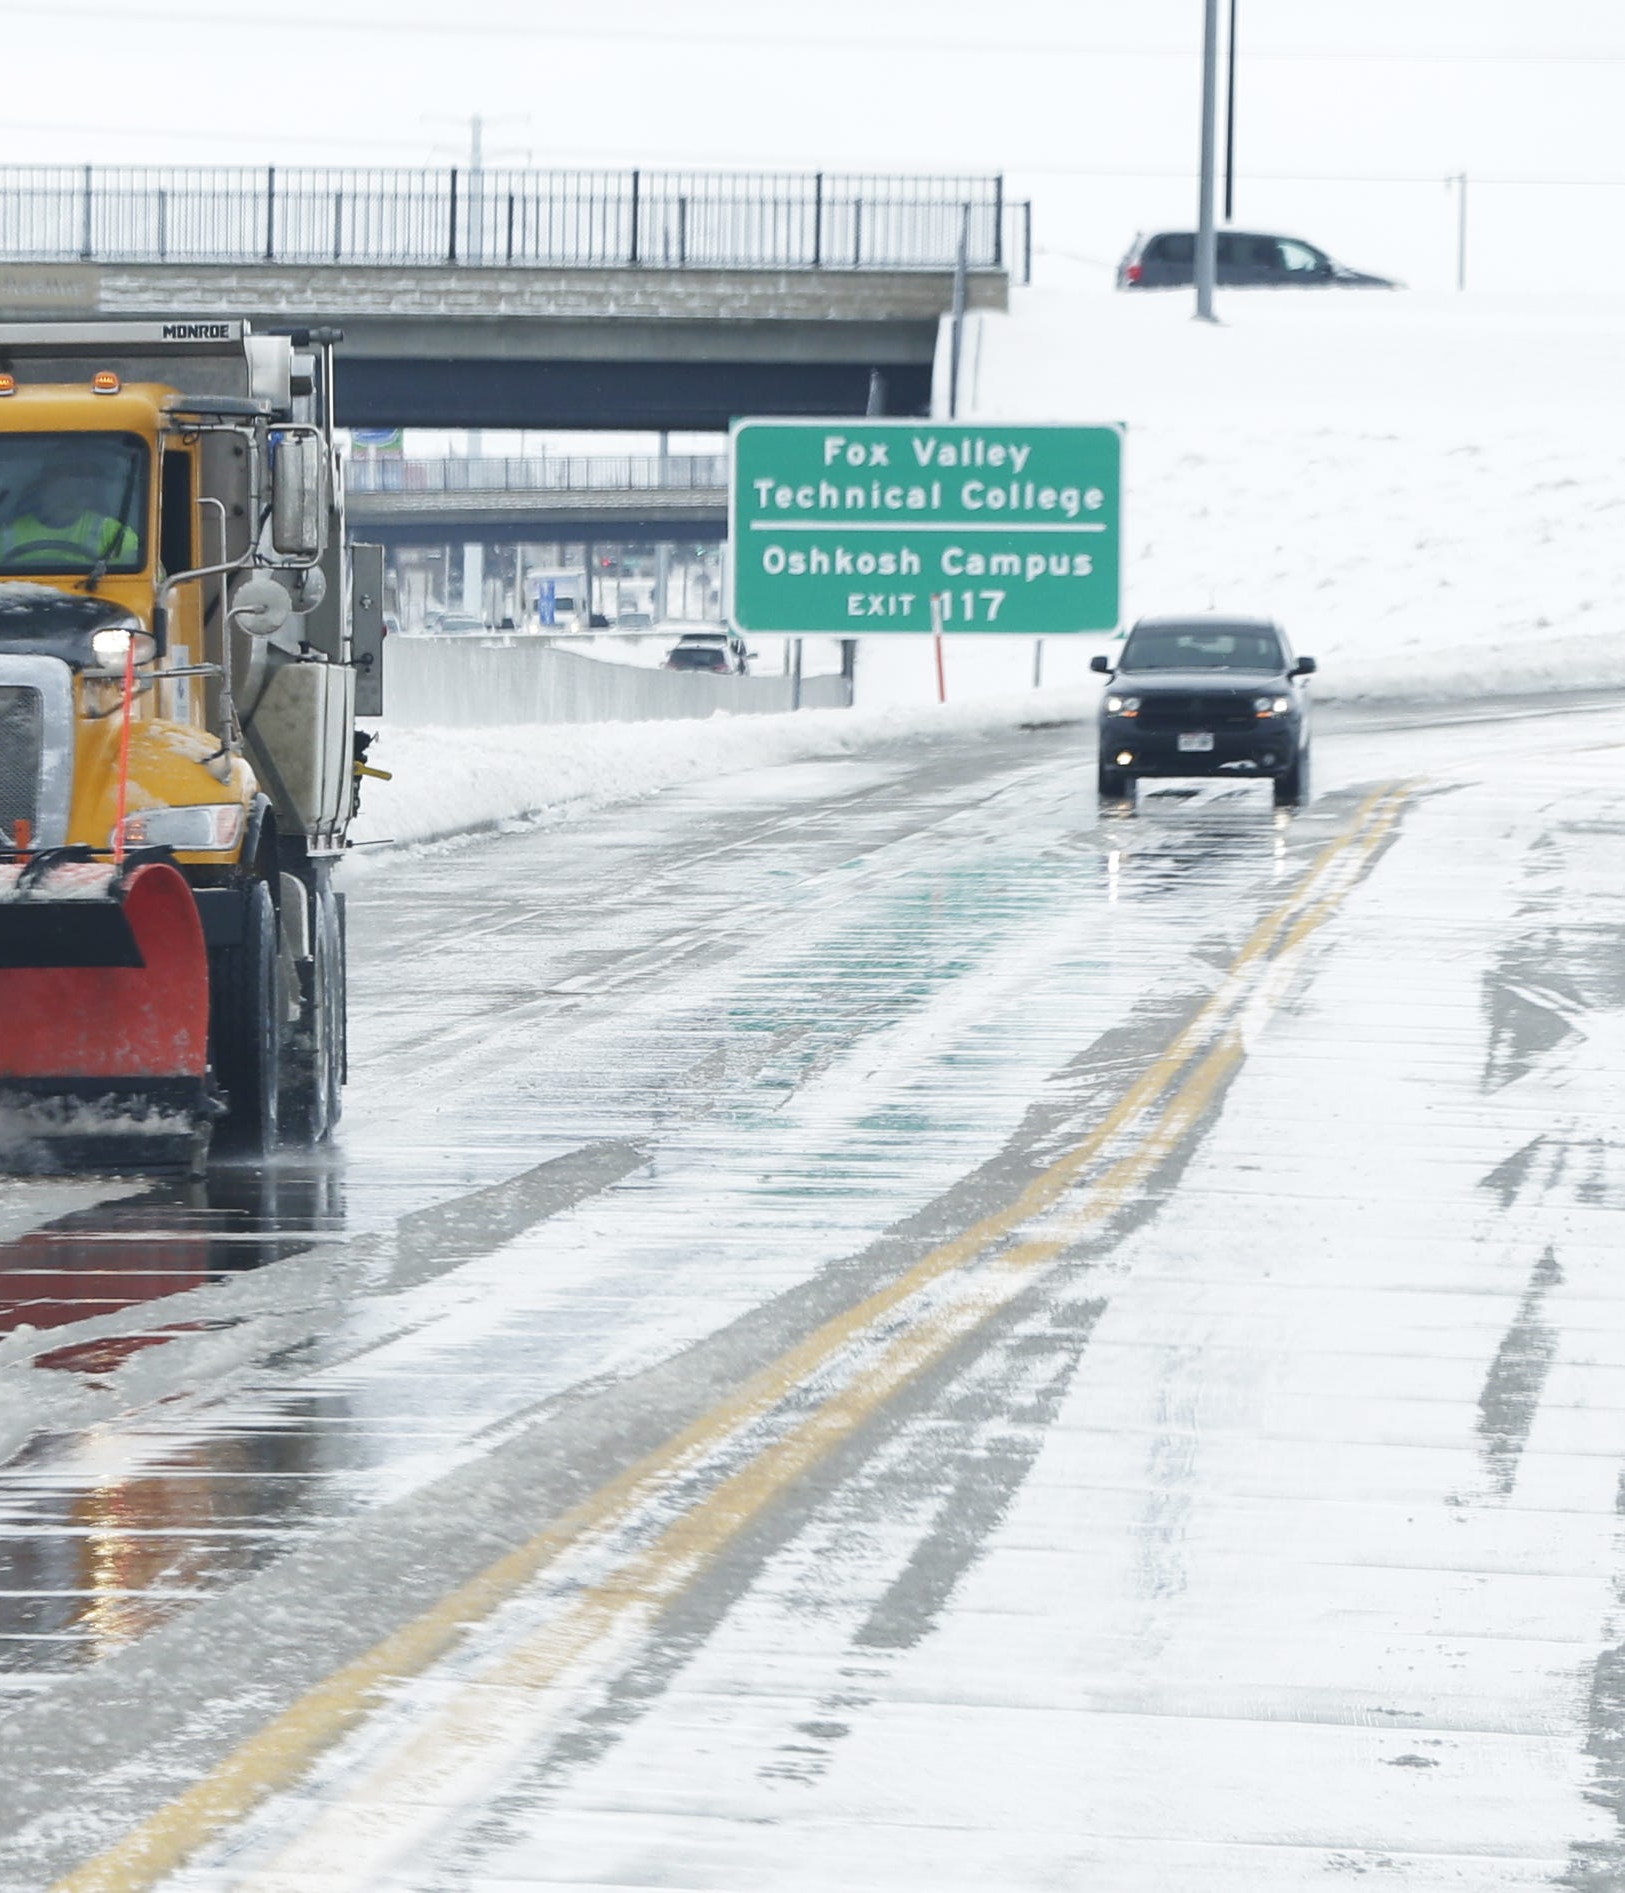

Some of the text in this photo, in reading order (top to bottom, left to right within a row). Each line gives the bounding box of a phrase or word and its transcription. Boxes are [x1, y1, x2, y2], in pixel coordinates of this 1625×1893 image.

[162, 324, 230, 339] MONROE
[823, 436, 1031, 474] Fox Valley
[753, 478, 1105, 518] Technical College
[762, 545, 1094, 582] Oshkosh Campus
[847, 589, 1007, 621] EXIT 117
